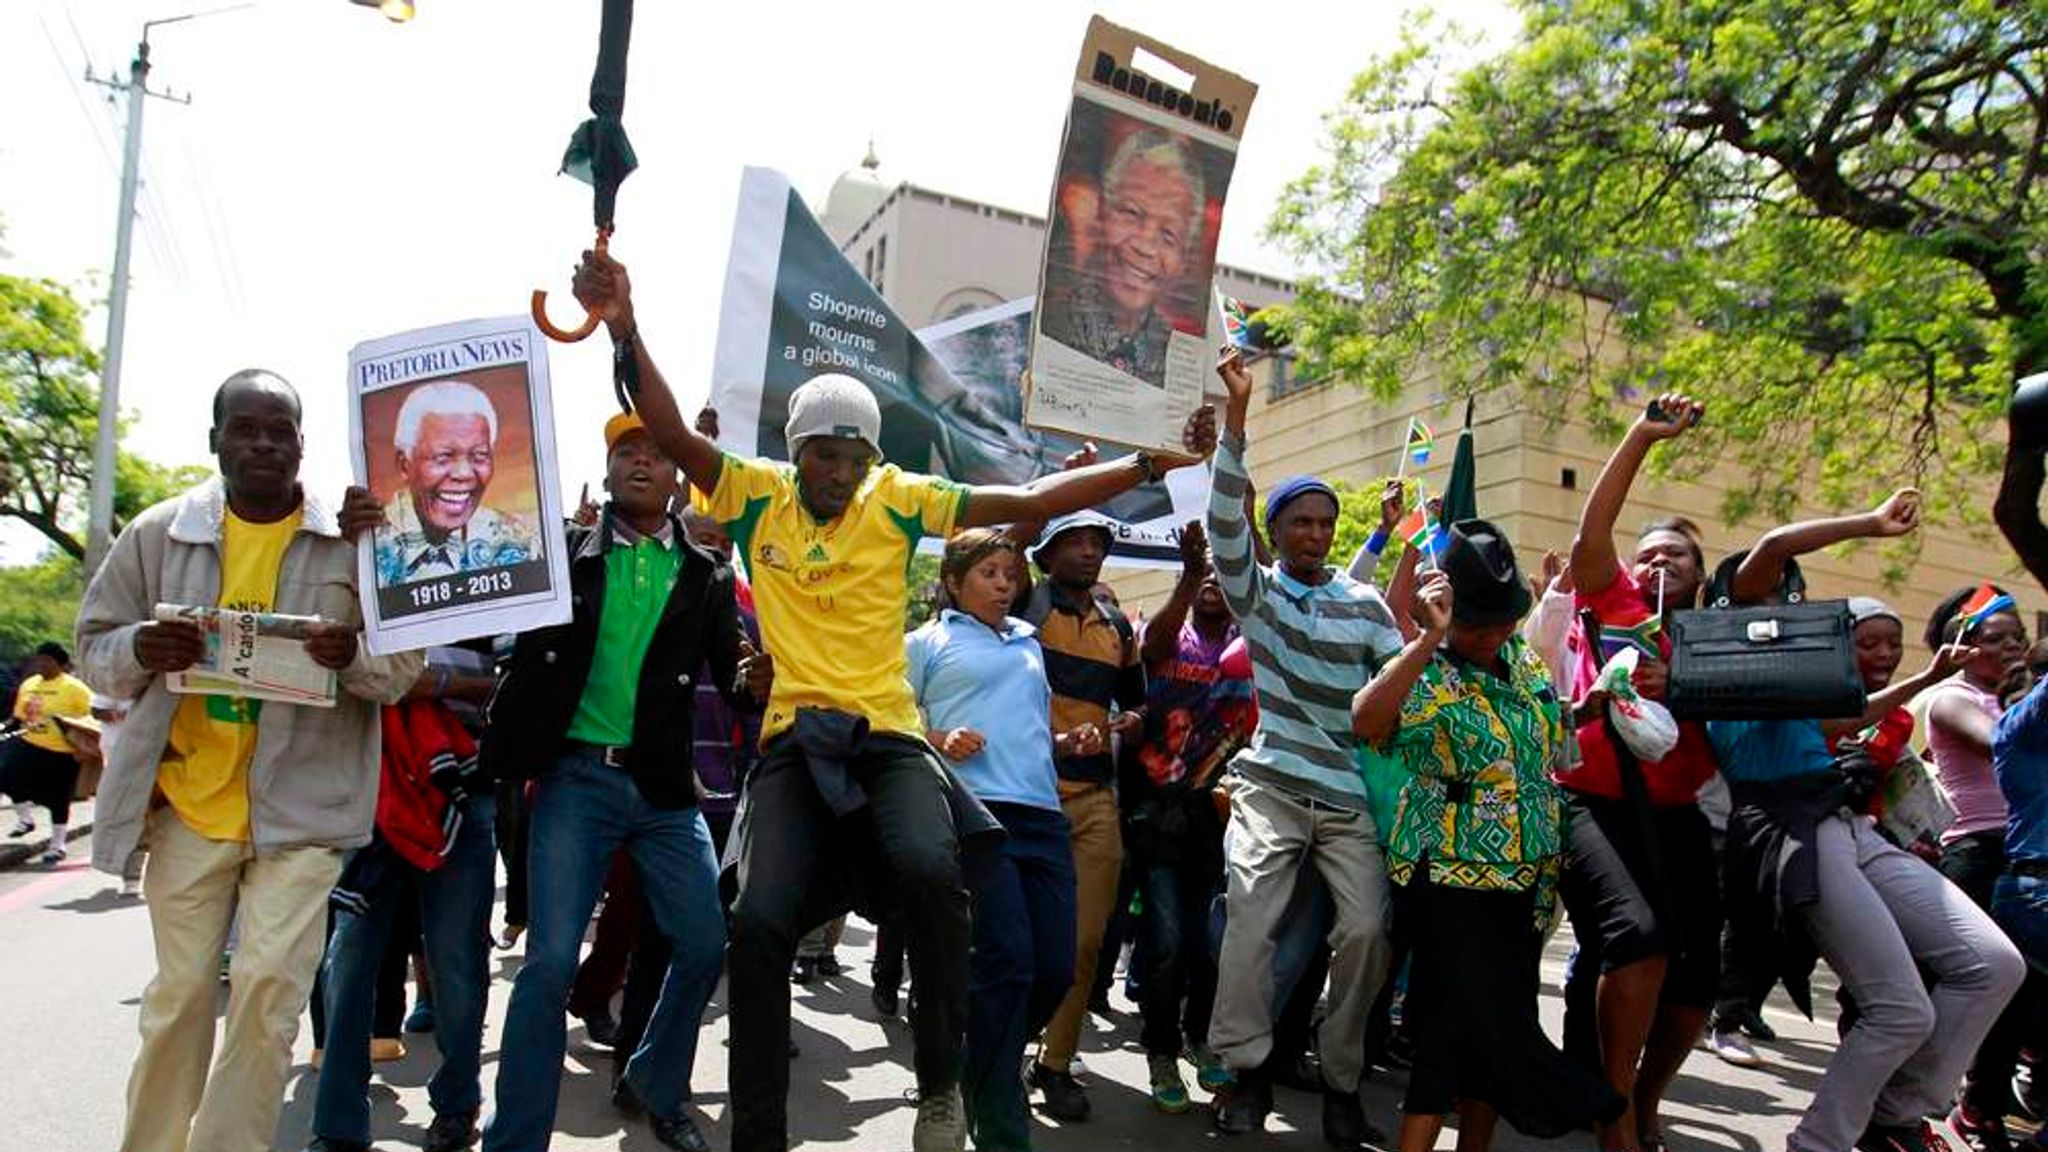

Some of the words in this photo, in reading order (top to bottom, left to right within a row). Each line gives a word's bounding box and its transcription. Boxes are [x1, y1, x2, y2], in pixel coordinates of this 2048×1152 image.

[808, 292, 887, 329] Shoprite
[808, 321, 876, 352] mourns
[361, 350, 460, 387] PRETORIA
[462, 337, 524, 363] NEWS
[783, 345, 796, 360] a
[802, 345, 860, 372] global
[864, 356, 897, 383] icon
[410, 581, 451, 607] 1918
[468, 571, 512, 596] 2013
[232, 667, 251, 679] A
